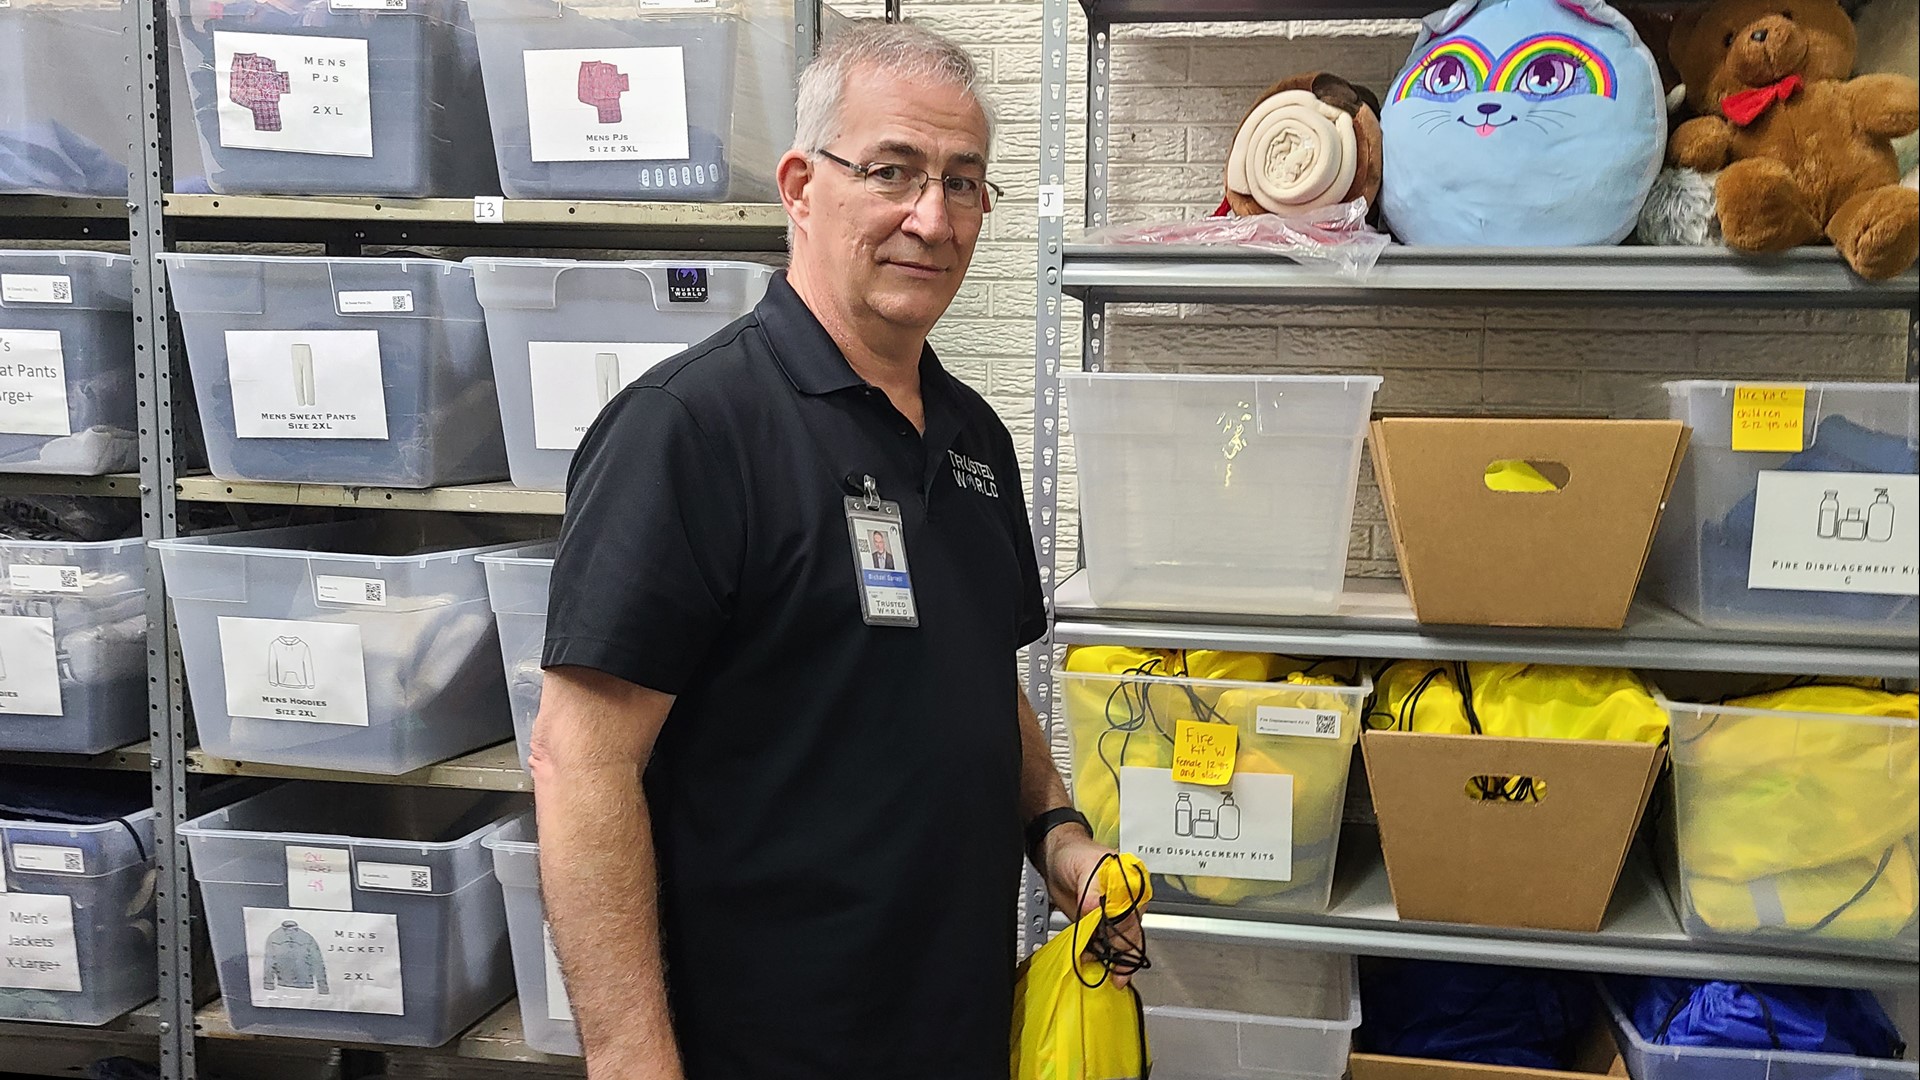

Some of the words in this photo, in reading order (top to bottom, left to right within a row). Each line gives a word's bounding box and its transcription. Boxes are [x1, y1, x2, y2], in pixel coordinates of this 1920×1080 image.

[304, 56, 346, 67] MENS
[312, 105, 343, 116] 2XL
[589, 145, 616, 153] SIZE
[620, 145, 638, 153] 3XL
[1042, 192, 1054, 207] J
[17, 364, 57, 378] Pants
[261, 413, 287, 421] MENS
[289, 412, 323, 421] SWEAT
[326, 413, 356, 421] PANTS
[288, 422, 310, 430] SIZE
[312, 422, 333, 430] 2XL
[947, 449, 995, 481] TRUSTED
[1805, 561, 1896, 574] DISPLACEMENT
[262, 696, 288, 704] MENS
[290, 698, 327, 707] HOODIES
[275, 708, 296, 716] SIZE
[298, 709, 317, 718] 2XL
[1186, 727, 1214, 746] Fire
[1166, 847, 1245, 859] DISPLACEMENT
[9, 911, 49, 925] Men's
[335, 930, 377, 940] MENS
[8, 935, 54, 948] Jackets
[328, 944, 385, 953] JACKET
[5, 956, 61, 972] X-Large+
[343, 972, 374, 981] 2XL
